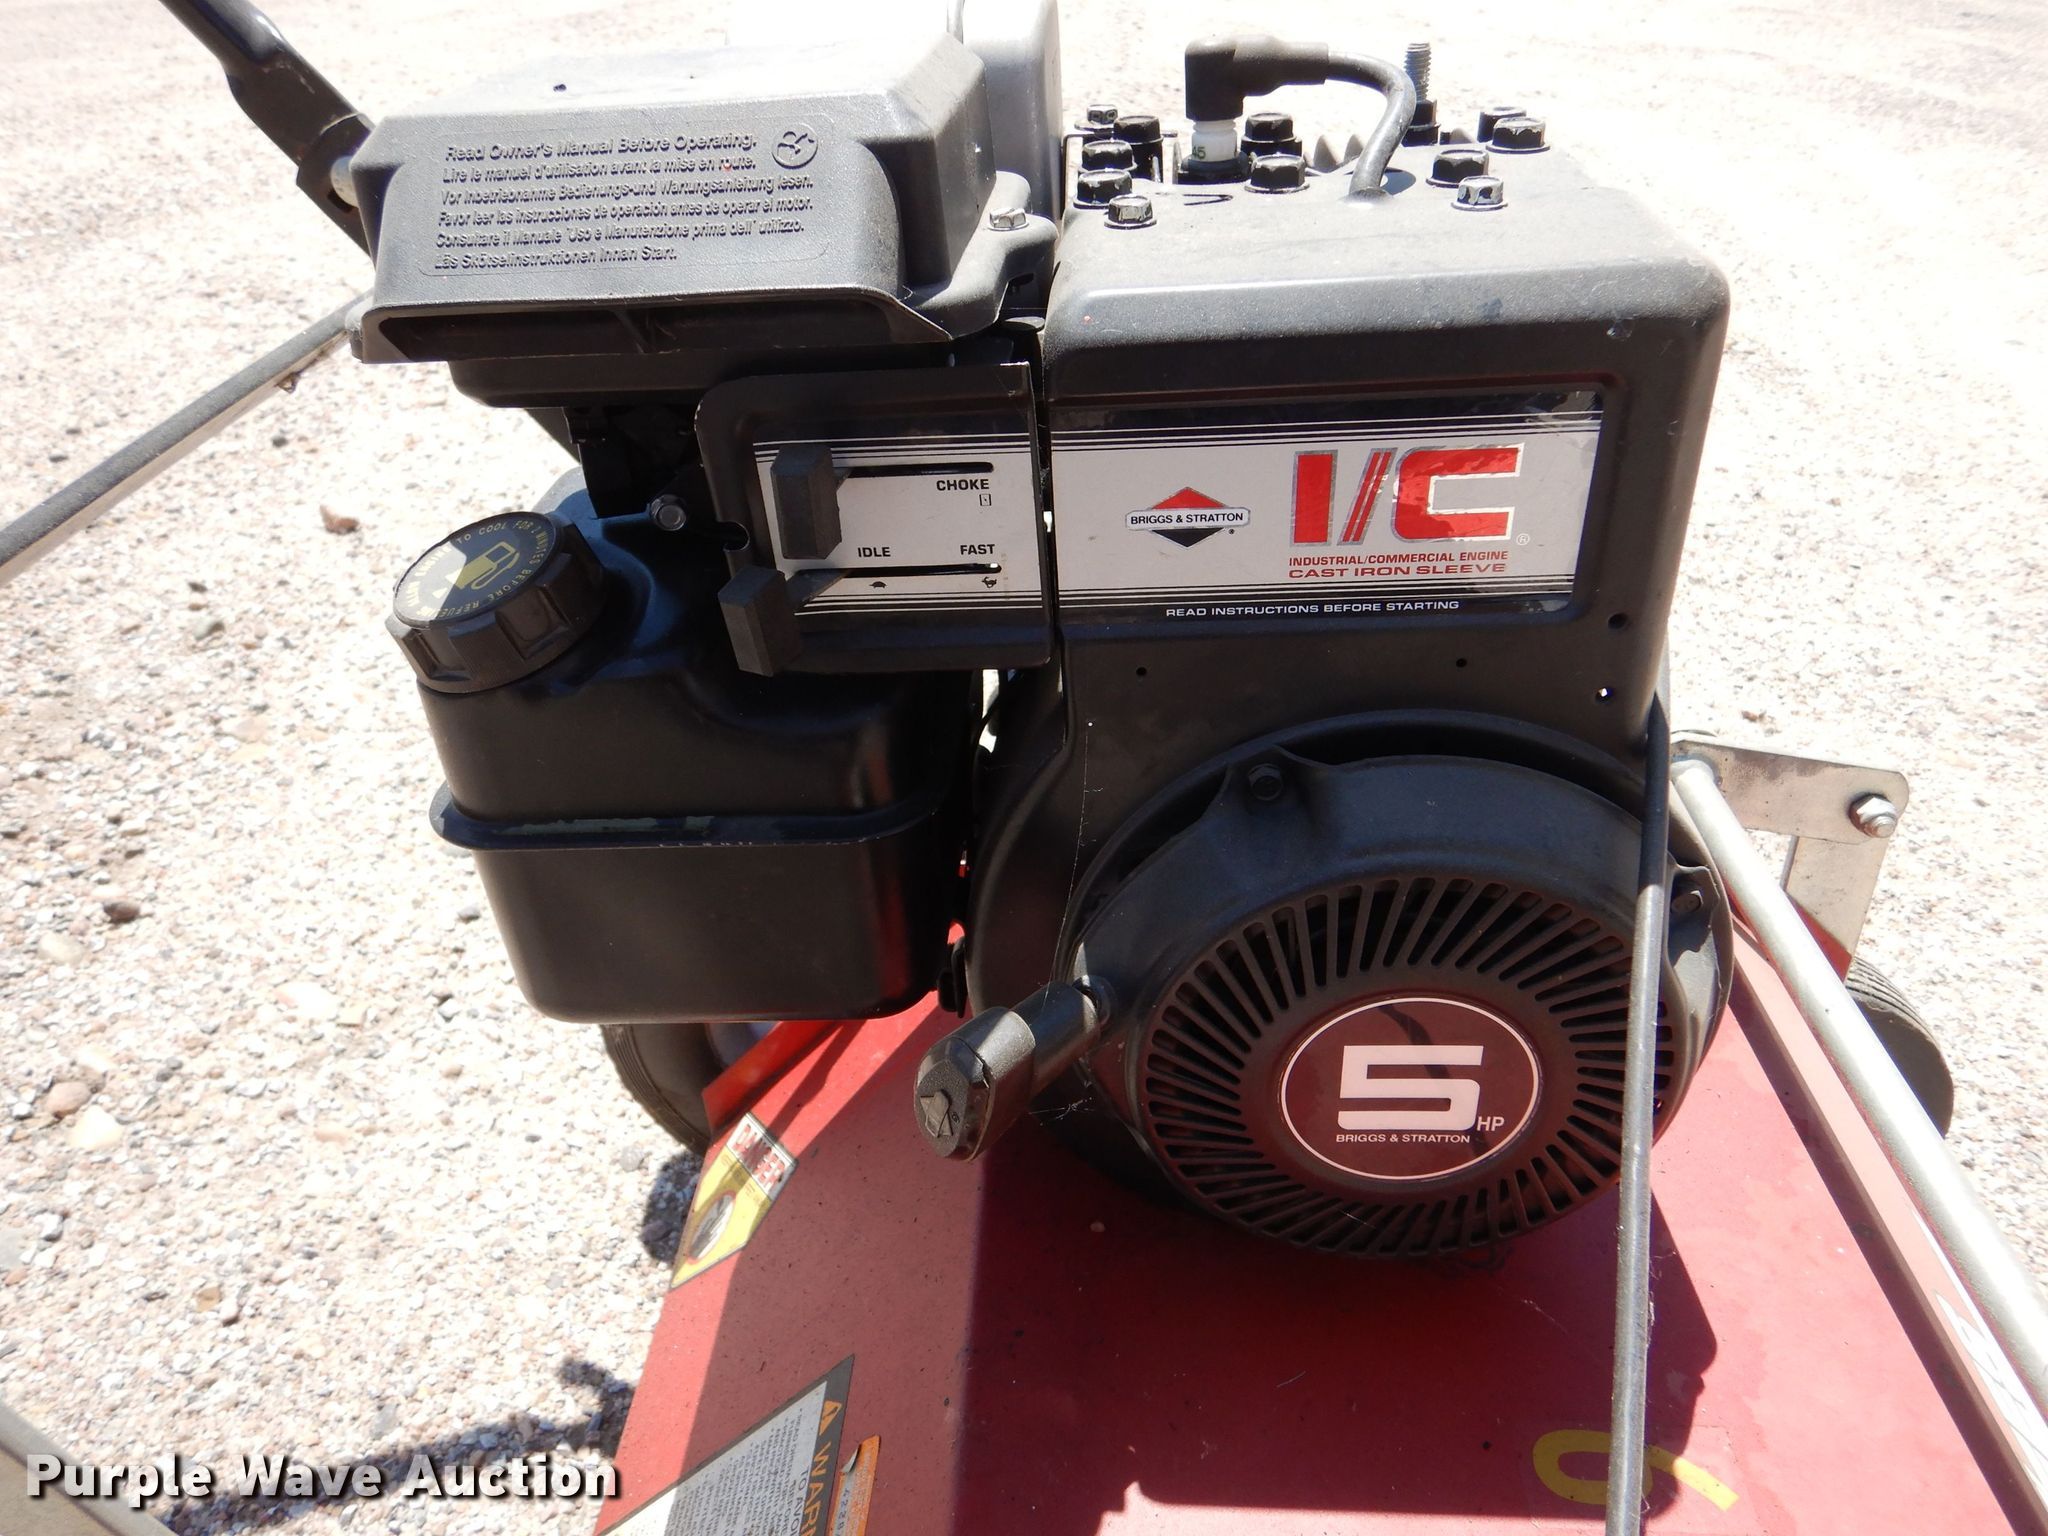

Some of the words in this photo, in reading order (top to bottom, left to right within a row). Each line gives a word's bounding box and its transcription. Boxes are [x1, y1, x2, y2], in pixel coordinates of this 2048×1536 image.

[446, 145, 486, 161] Read
[490, 143, 552, 160] Owner's
[556, 138, 614, 157] Manual
[618, 137, 670, 154] Before
[936, 478, 990, 492] CHOKE
[1130, 513, 1174, 526] BRIGGS
[1175, 513, 1184, 524] &
[1185, 512, 1245, 524] STRATTON
[478, 522, 508, 536] COOL
[456, 534, 472, 544] TO
[857, 546, 892, 558] IDLE
[960, 544, 996, 556] FAST
[1288, 552, 1455, 568] INDUSTRIAL/COMMERCIAL
[1458, 551, 1508, 562] ENGINE
[1288, 567, 1348, 579] CAST
[1354, 566, 1412, 578] IRON
[1415, 563, 1507, 576] SLEEVE
[488, 568, 532, 600] BEFORE
[1166, 608, 1208, 617] READ
[1211, 604, 1319, 616] INSTRUCTIONS
[1324, 603, 1382, 614] BEFORE
[1385, 600, 1460, 612] STARTING
[1338, 1045, 1484, 1130] 5
[1476, 1116, 1505, 1132] HP
[1336, 1134, 1386, 1144] BRIGGS
[1390, 1134, 1398, 1143] &
[1402, 1134, 1470, 1144] STRATTON
